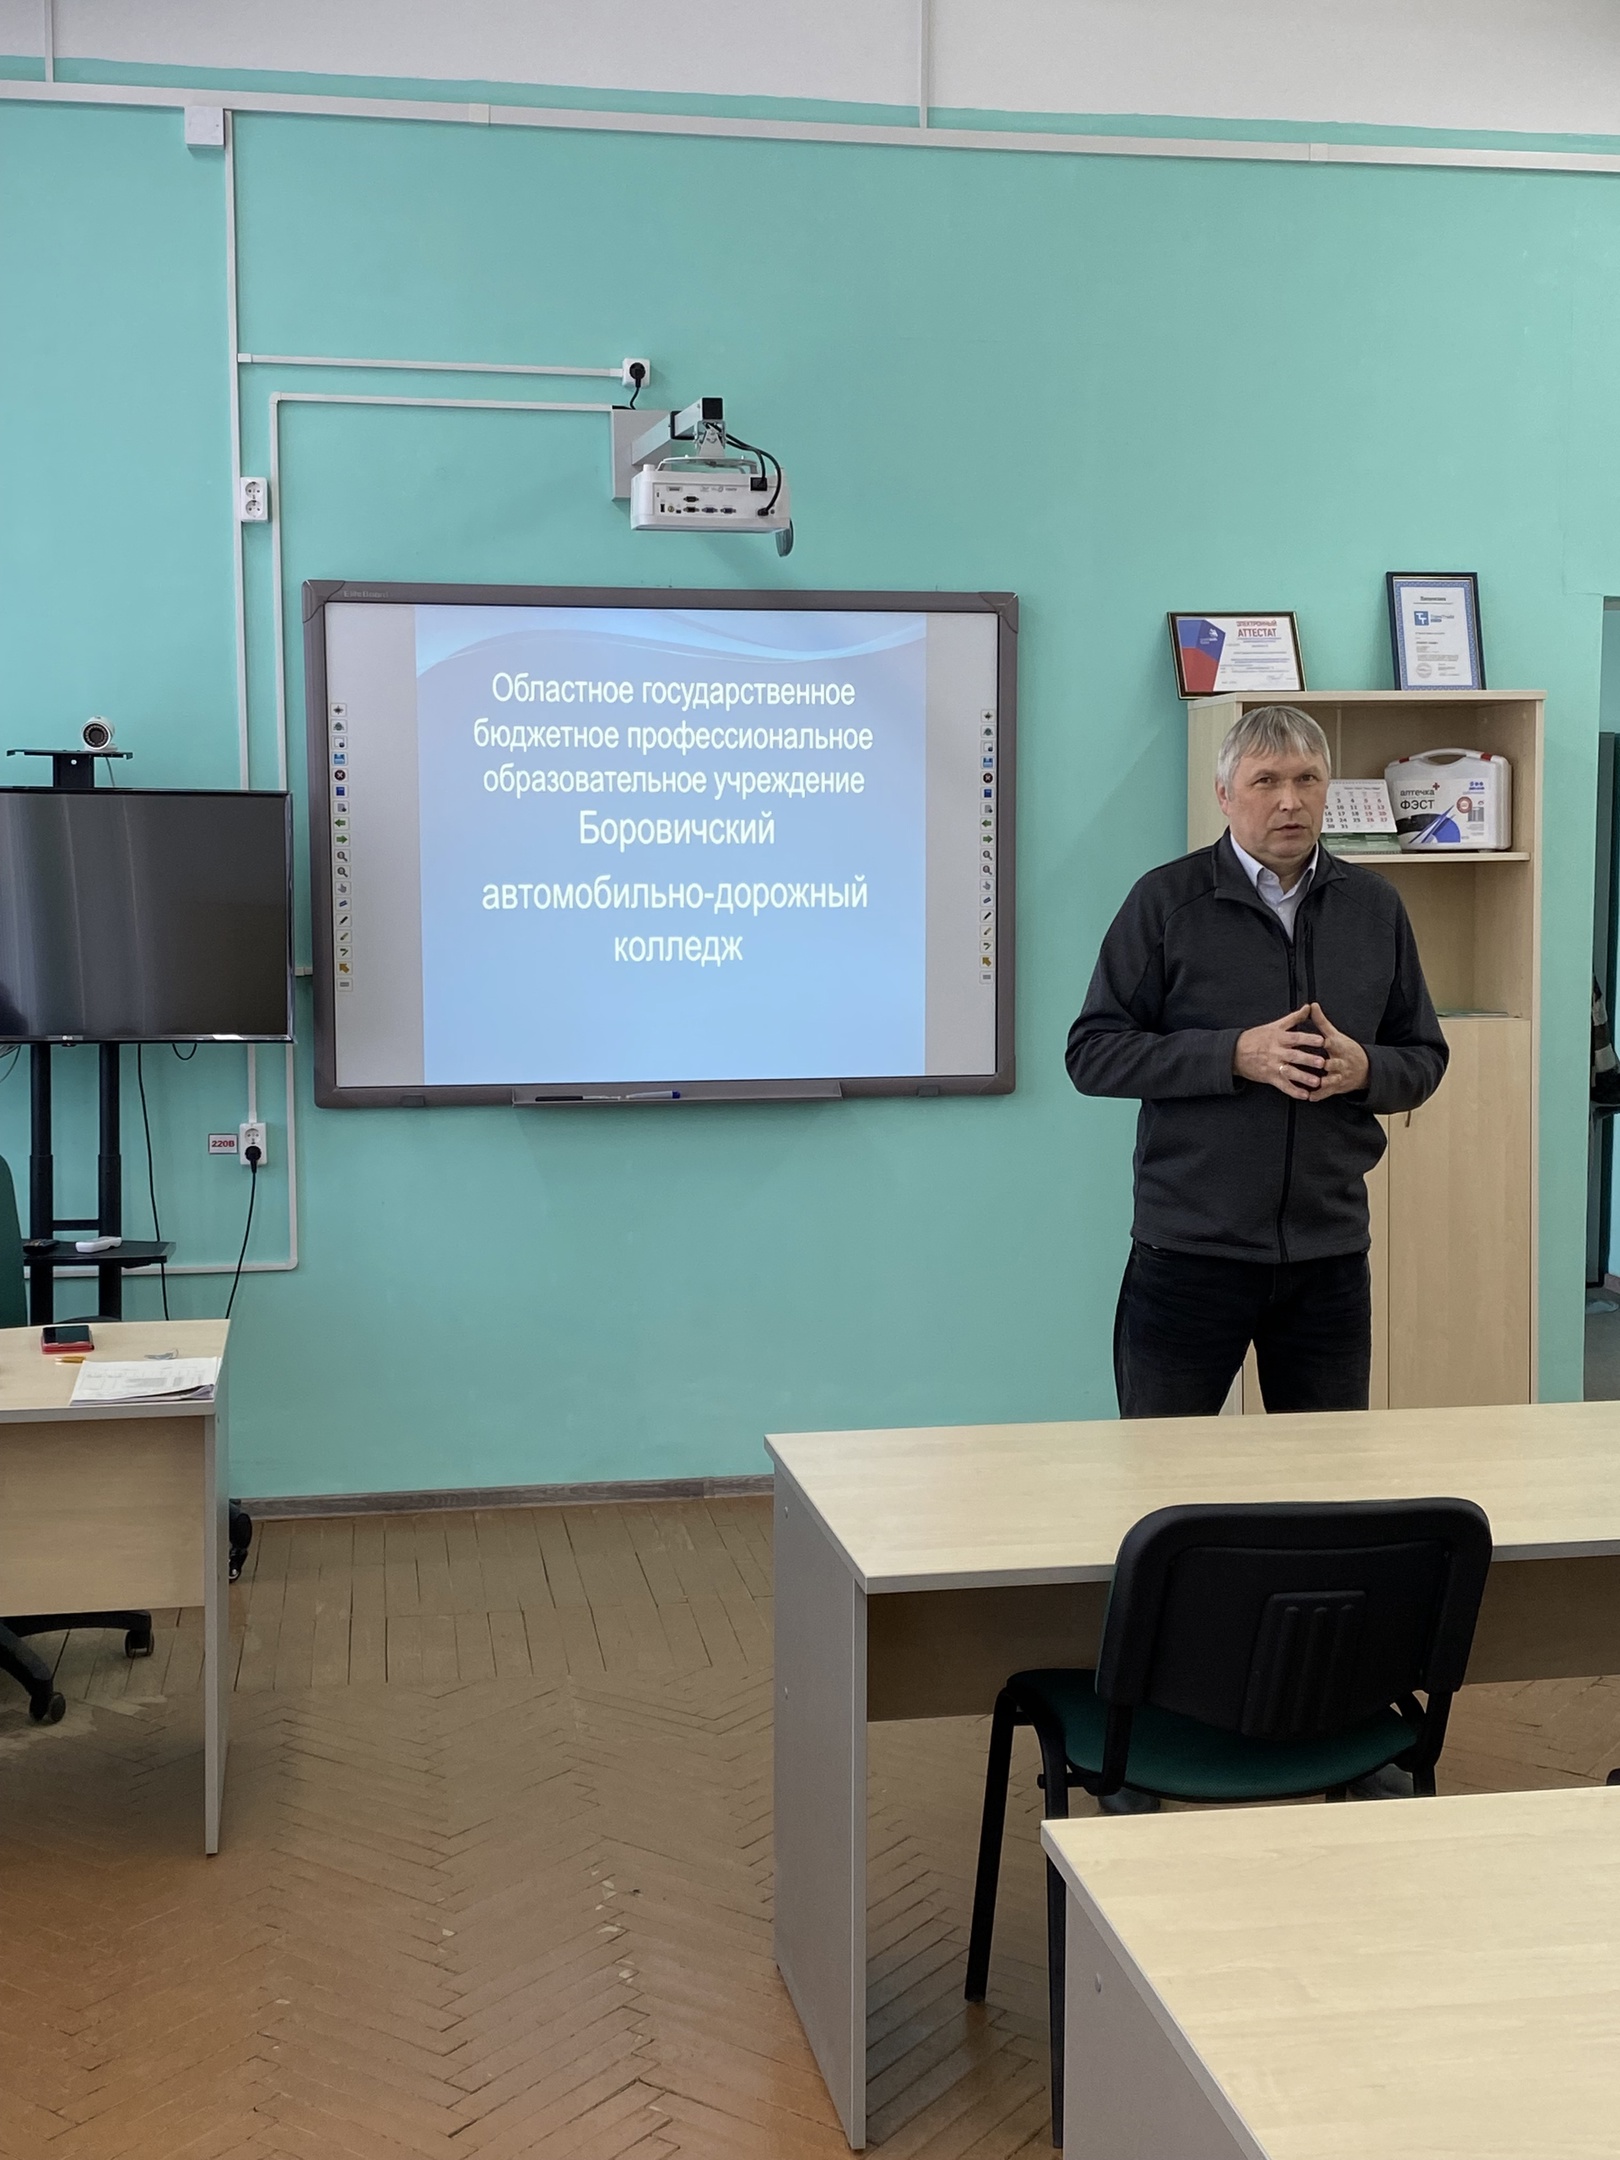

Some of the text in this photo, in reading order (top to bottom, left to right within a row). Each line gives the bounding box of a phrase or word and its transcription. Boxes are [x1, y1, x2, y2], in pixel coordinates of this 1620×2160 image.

[1238, 628, 1277, 637] АТТЕСТАТ
[492, 672, 856, 711] Областное государственное
[473, 718, 873, 755] бюджетное профессиональное
[483, 763, 865, 799] образовательное учреждение
[1400, 789, 1435, 797] аптечка
[1400, 799, 1435, 810] ФЭСТ
[579, 810, 775, 852] Боровичский
[482, 874, 869, 916] автомобильно-дорожный
[614, 935, 744, 967] колледж
